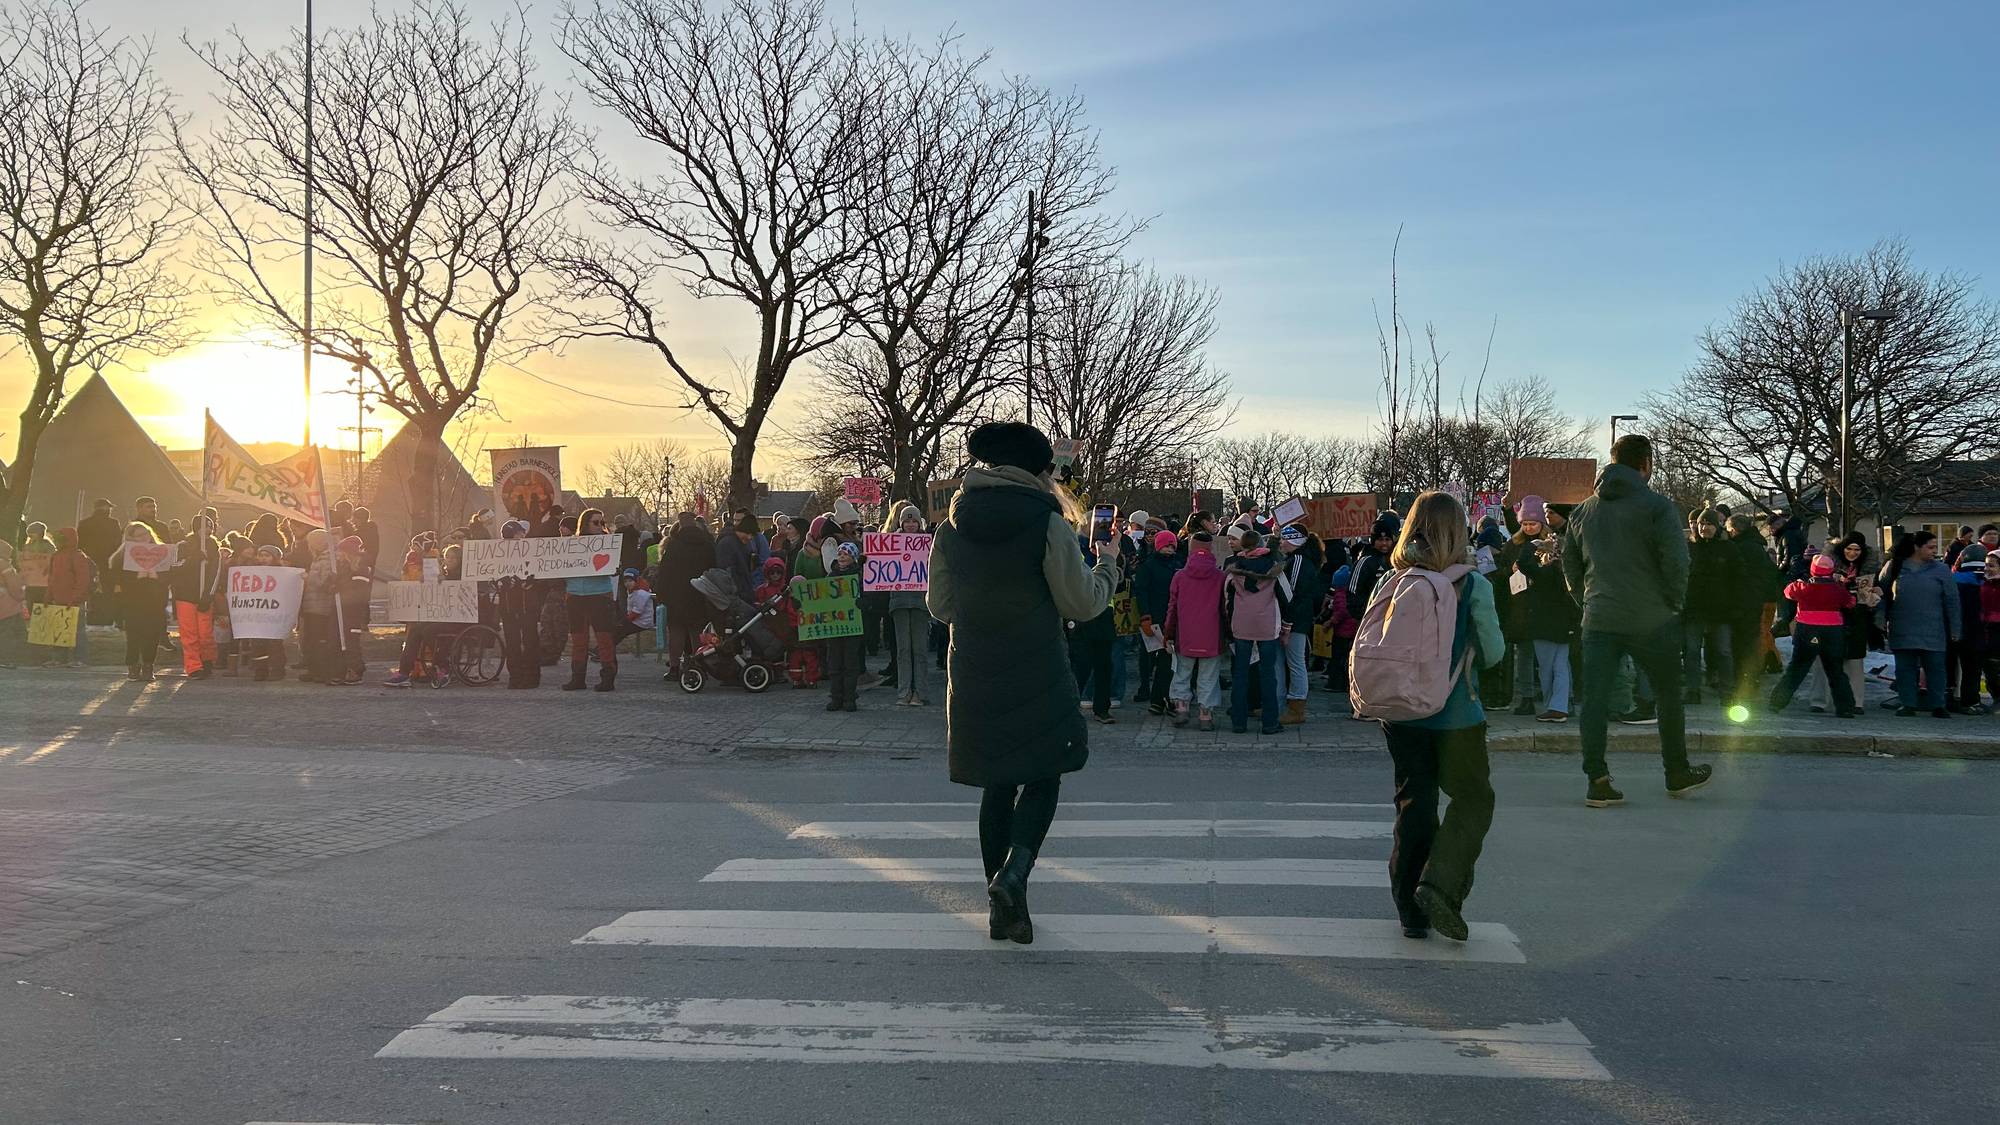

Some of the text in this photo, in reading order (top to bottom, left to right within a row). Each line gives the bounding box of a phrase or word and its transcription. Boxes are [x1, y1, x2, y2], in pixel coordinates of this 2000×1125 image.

[466, 535, 620, 561] HUNSTAD BARNESKOLE
[865, 535, 932, 552] IKKE RØR
[537, 559, 564, 572] REDD
[232, 571, 277, 593] REDD
[231, 596, 281, 610] HUNSTAD
